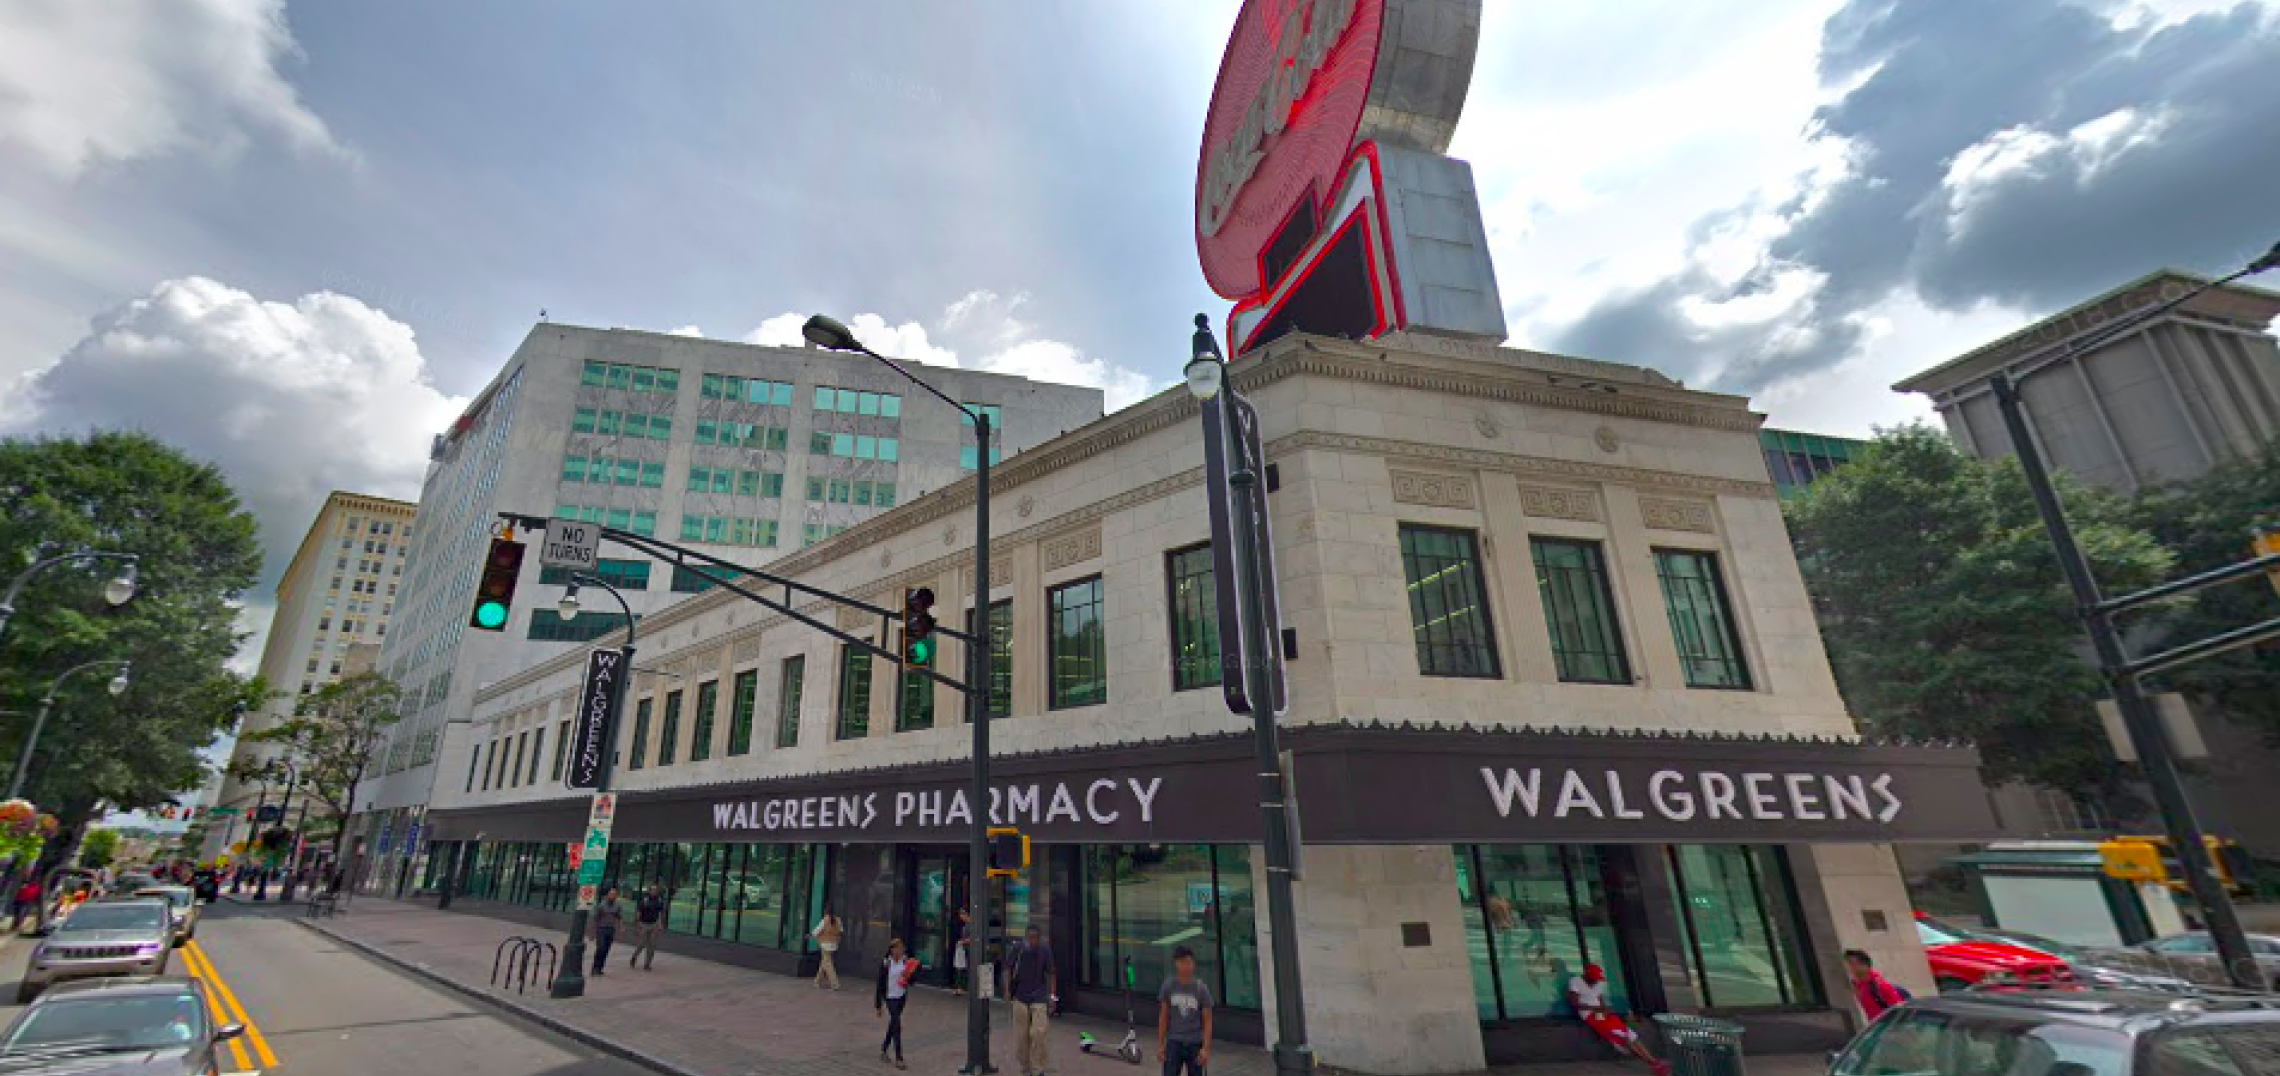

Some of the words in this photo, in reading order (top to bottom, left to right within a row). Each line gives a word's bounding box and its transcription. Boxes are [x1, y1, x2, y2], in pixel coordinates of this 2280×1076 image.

[548, 542, 592, 564] TURNS
[562, 526, 585, 544] NO
[580, 653, 619, 784] WALGREENS
[713, 792, 877, 830] WALGREENS
[895, 777, 1162, 825] PHARMACY
[1480, 766, 1902, 822] WALGREENS
